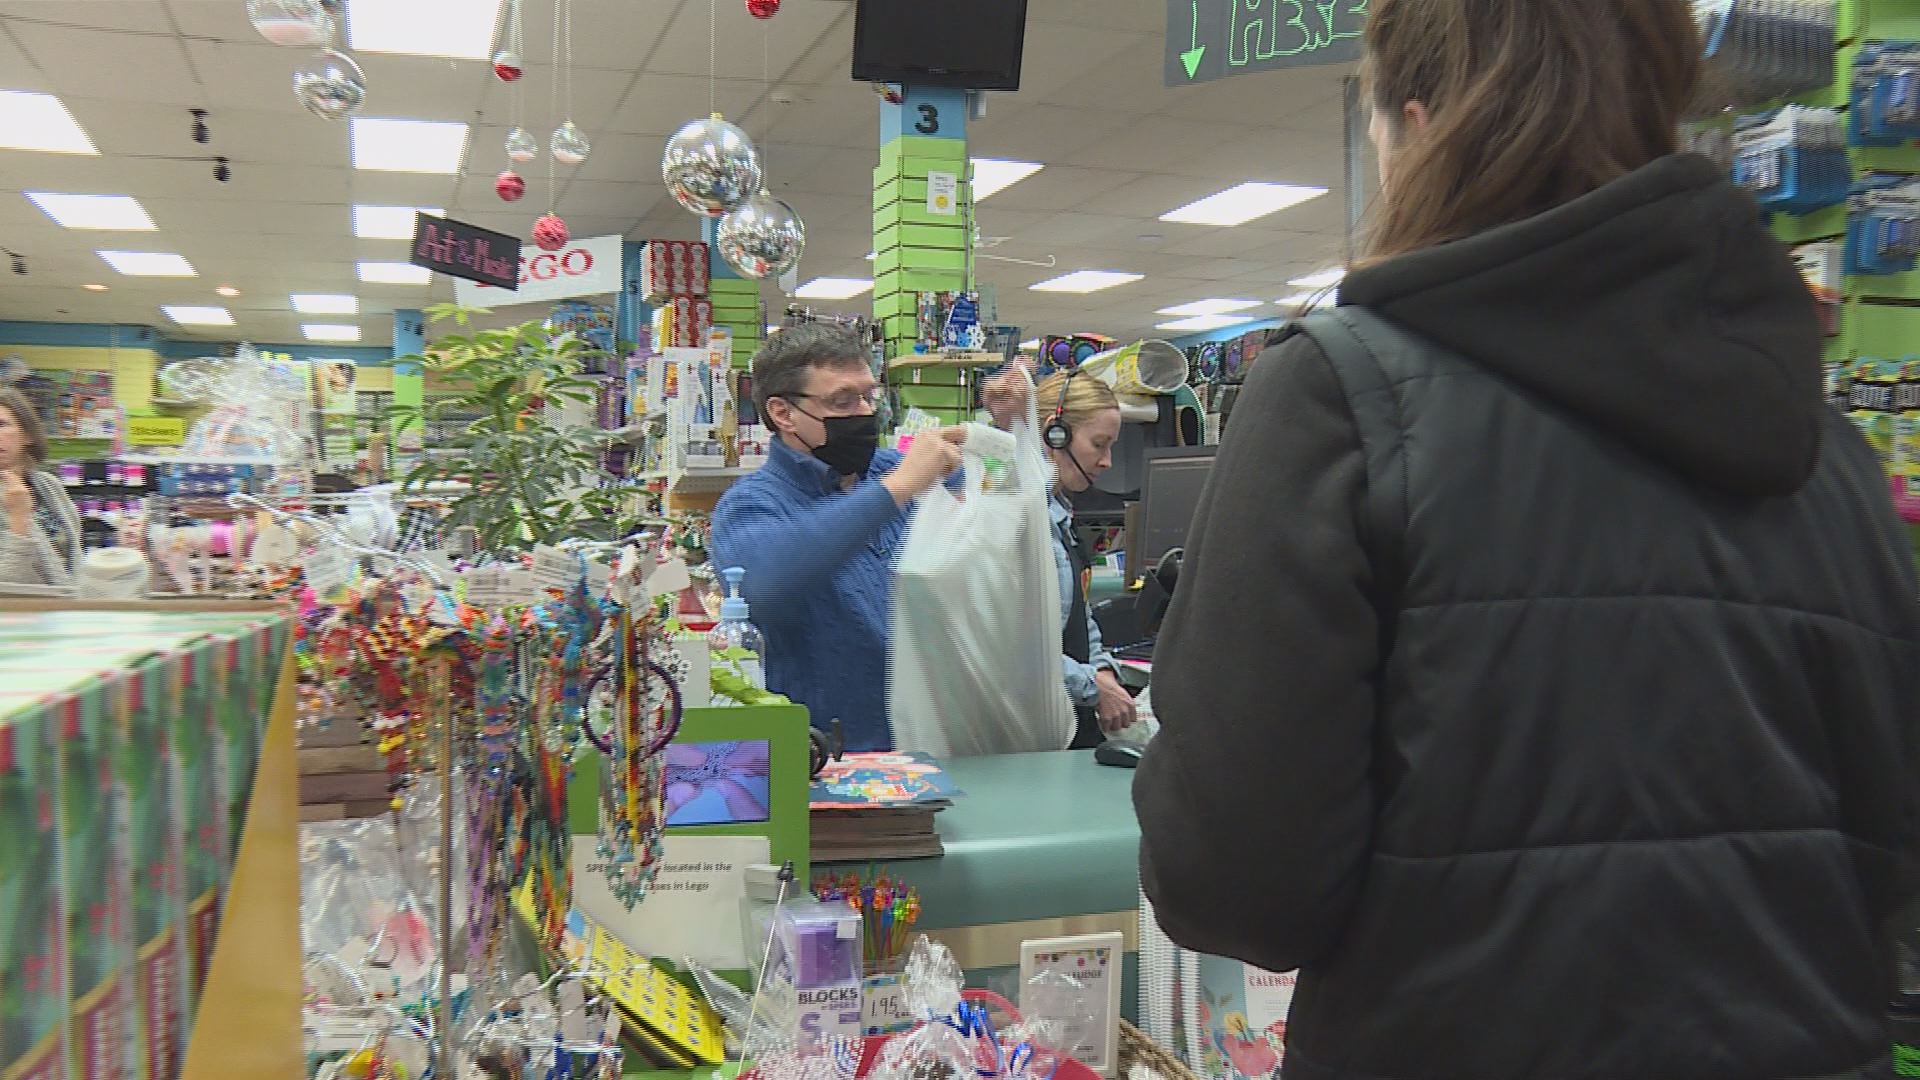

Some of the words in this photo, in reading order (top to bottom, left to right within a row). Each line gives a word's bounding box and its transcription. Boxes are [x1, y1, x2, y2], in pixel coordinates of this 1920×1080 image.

[915, 104, 939, 134] 3
[417, 223, 458, 265] Art
[457, 240, 475, 267] &
[474, 239, 516, 281] Music
[629, 280, 638, 295] 5
[663, 862, 702, 872] located
[702, 862, 714, 872] in
[714, 861, 732, 872] the
[673, 881, 683, 891] in
[685, 881, 709, 893] Lego
[798, 987, 858, 1005] BLOCKS
[871, 995, 898, 1016] 1.95
